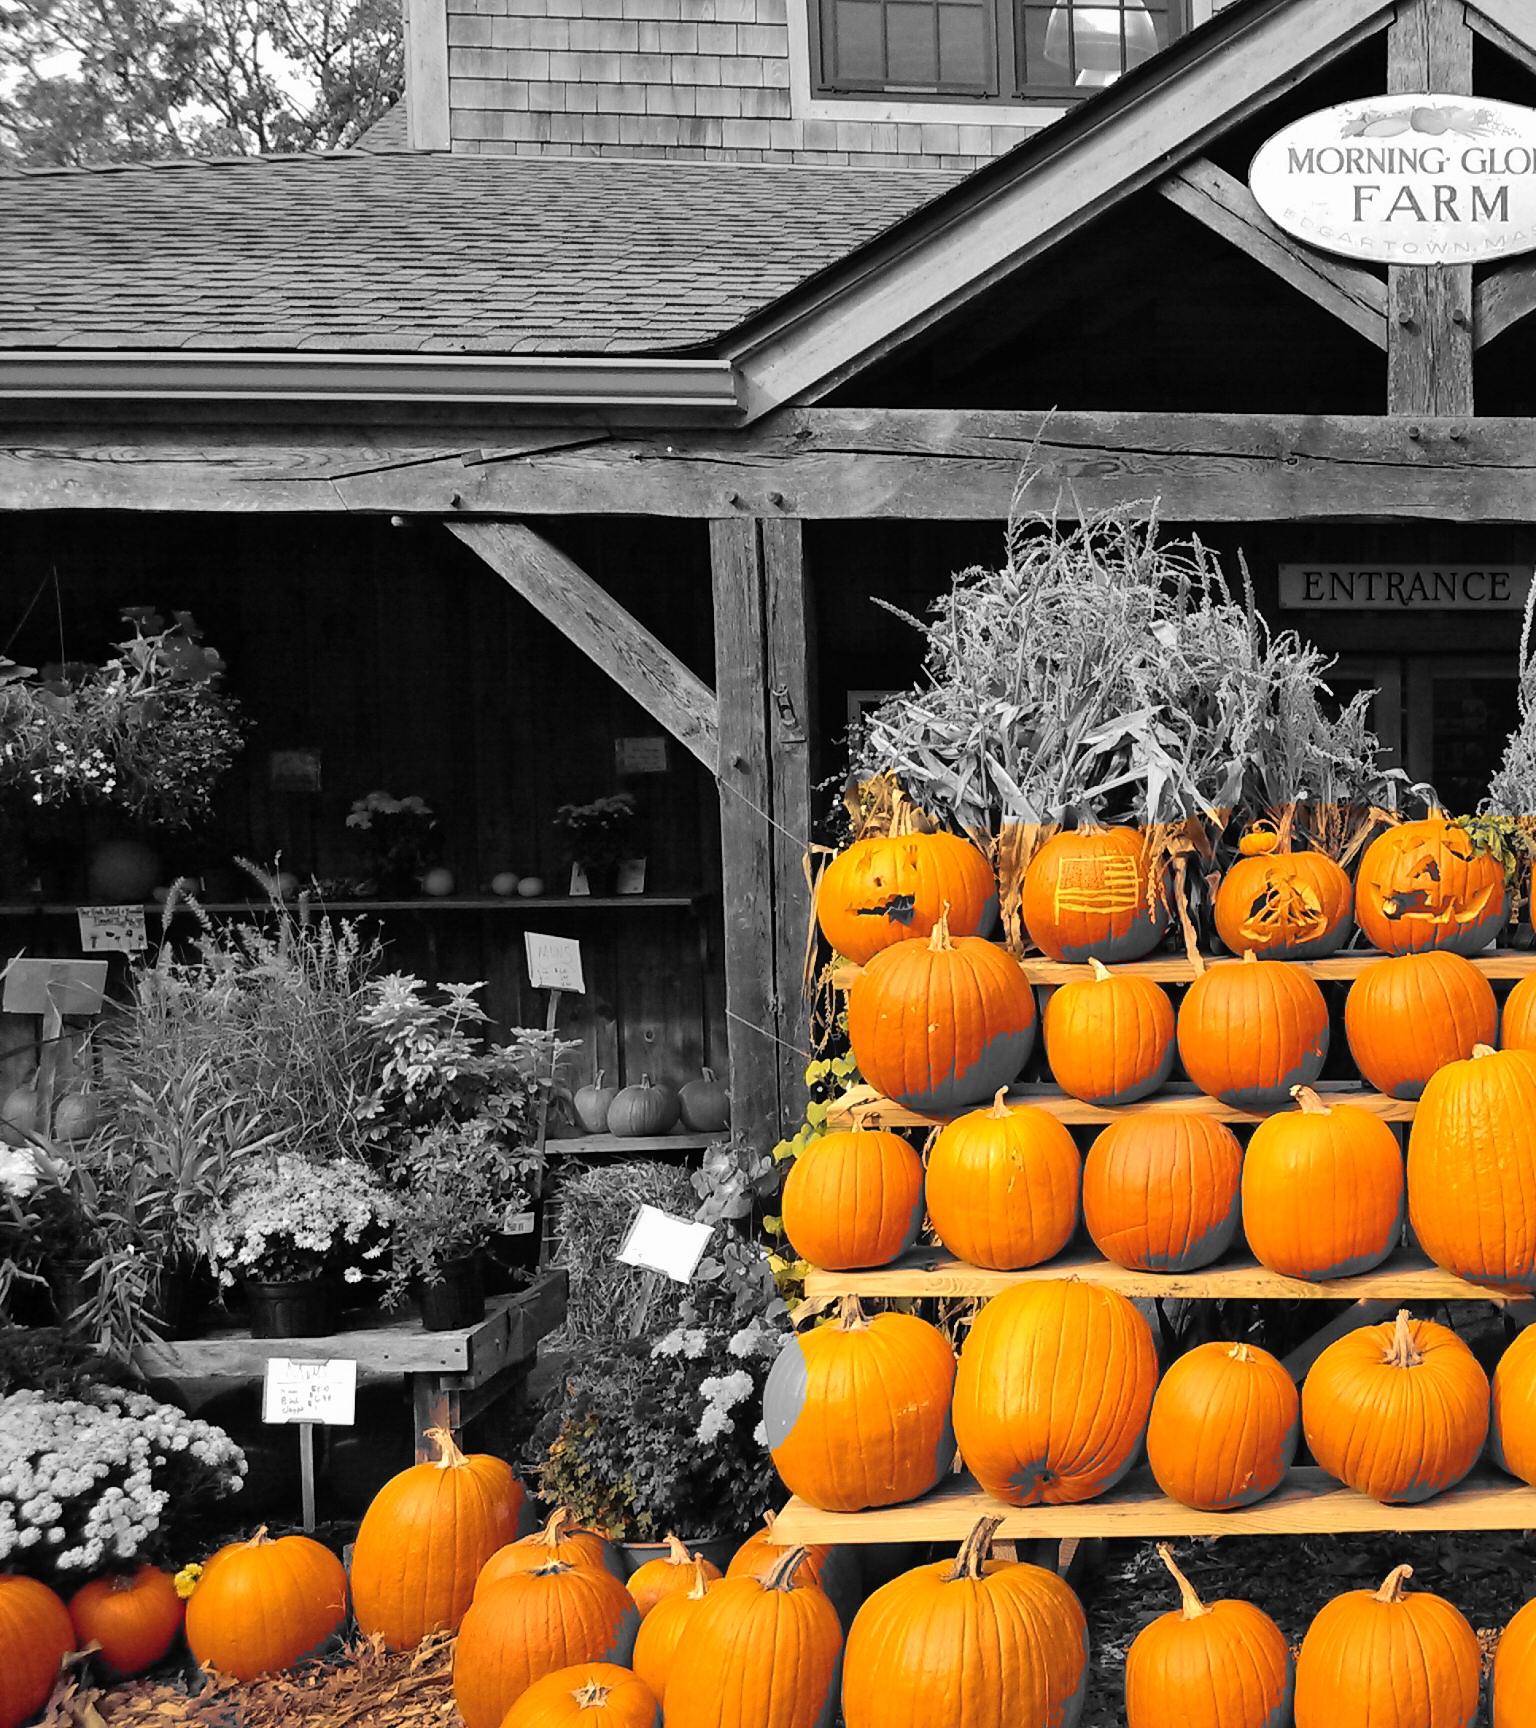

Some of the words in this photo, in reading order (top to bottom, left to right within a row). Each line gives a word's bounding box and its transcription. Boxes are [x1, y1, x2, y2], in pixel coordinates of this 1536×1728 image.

[1287, 146, 1445, 175] MORNING
[1352, 184, 1510, 222] FARM
[1302, 571, 1511, 606] ENTRANCE
